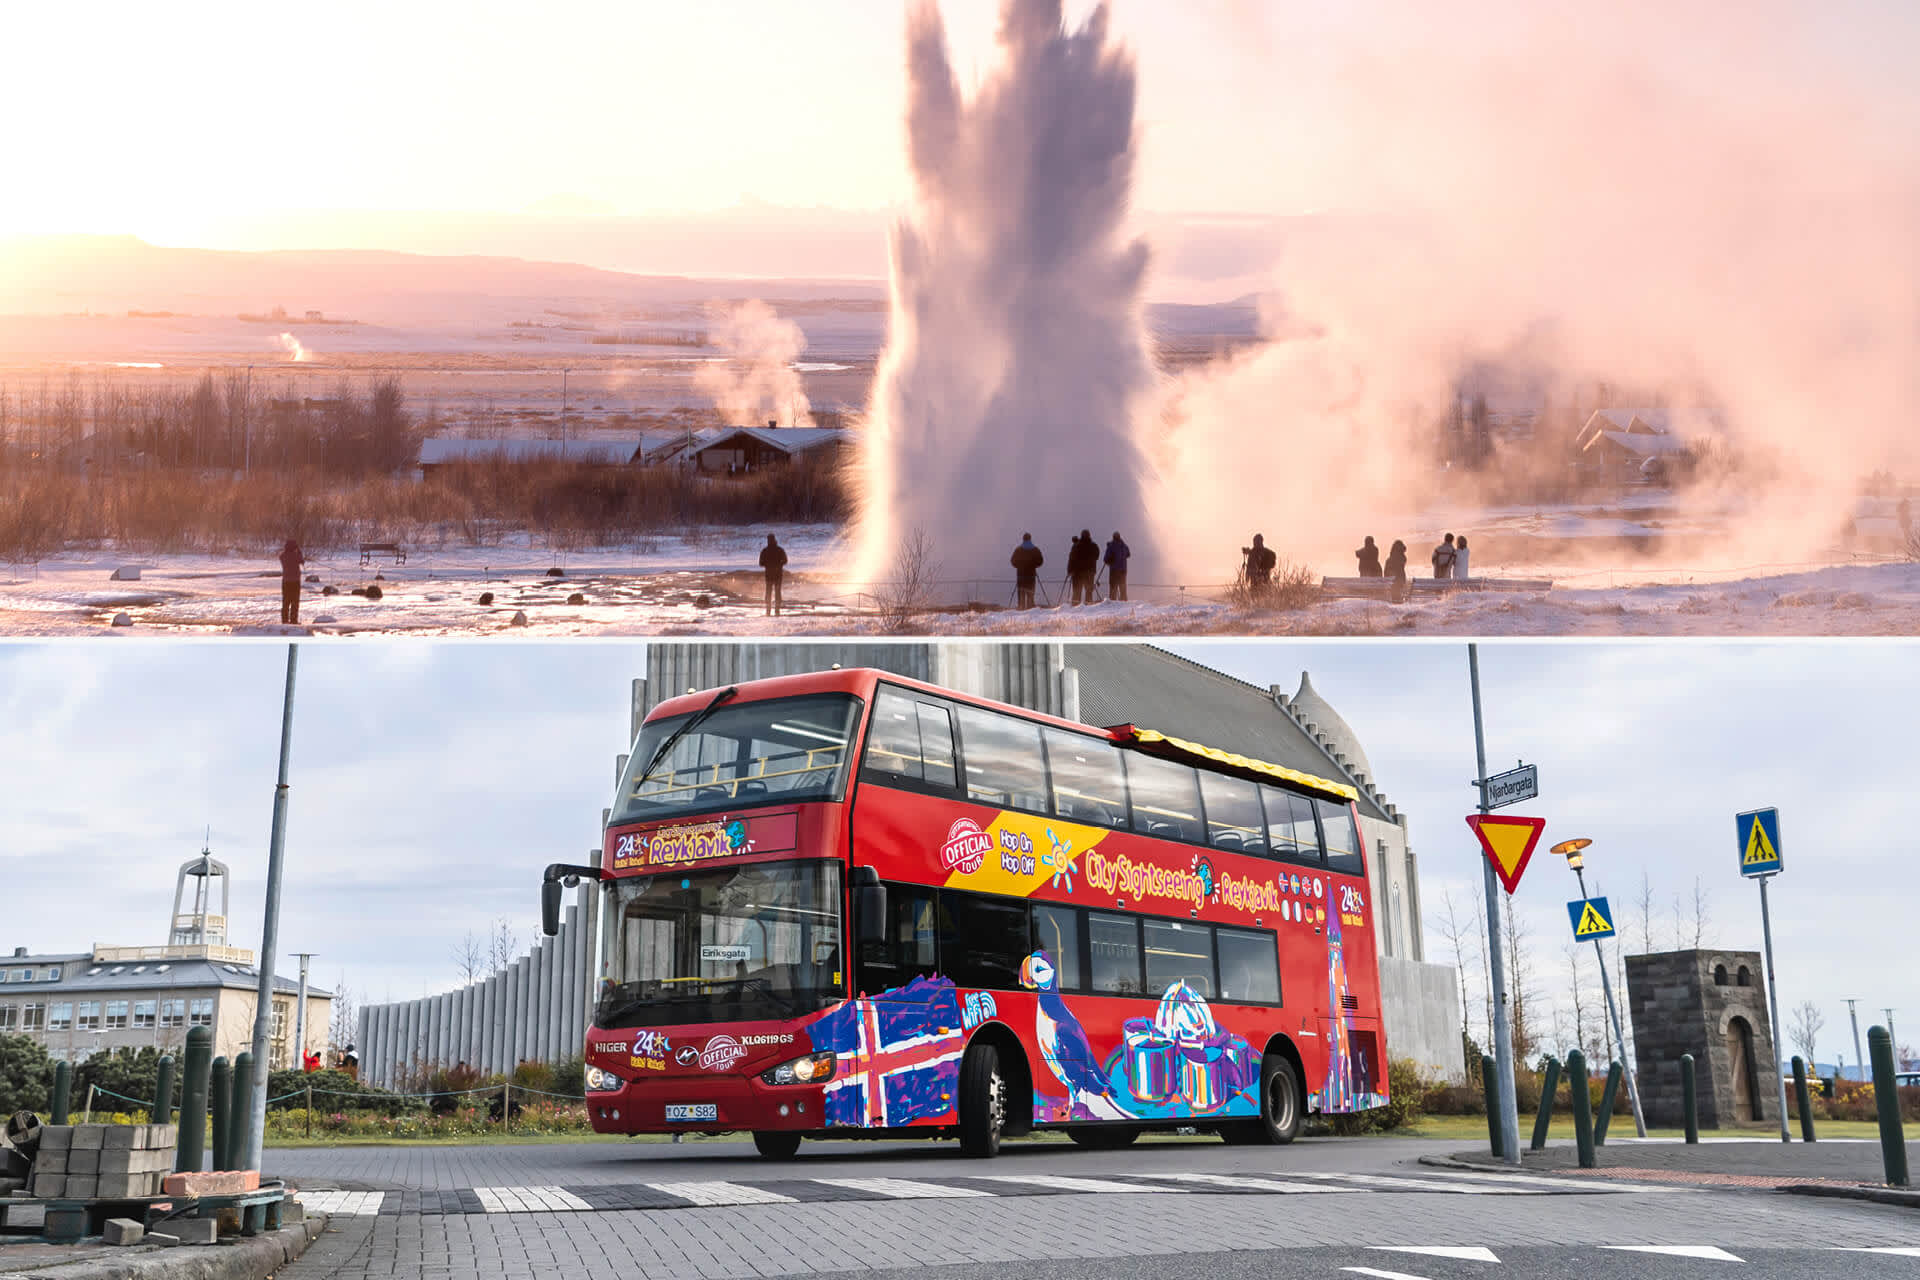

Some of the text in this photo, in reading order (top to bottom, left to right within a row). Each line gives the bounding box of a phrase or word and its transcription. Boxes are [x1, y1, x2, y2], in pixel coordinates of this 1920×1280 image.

[616, 834, 635, 858] 24
[945, 835, 992, 864] OFFICIAL
[1000, 829, 1019, 852] Hop
[1020, 832, 1033, 853] On
[961, 859, 983, 873] TOUR
[1000, 852, 1035, 876] Hop Off
[595, 1042, 627, 1053] HIGER
[632, 1030, 655, 1056] 24
[703, 1046, 744, 1065] OFFICIAL
[716, 1059, 735, 1071] TOUR
[695, 1105, 715, 1117] S82
